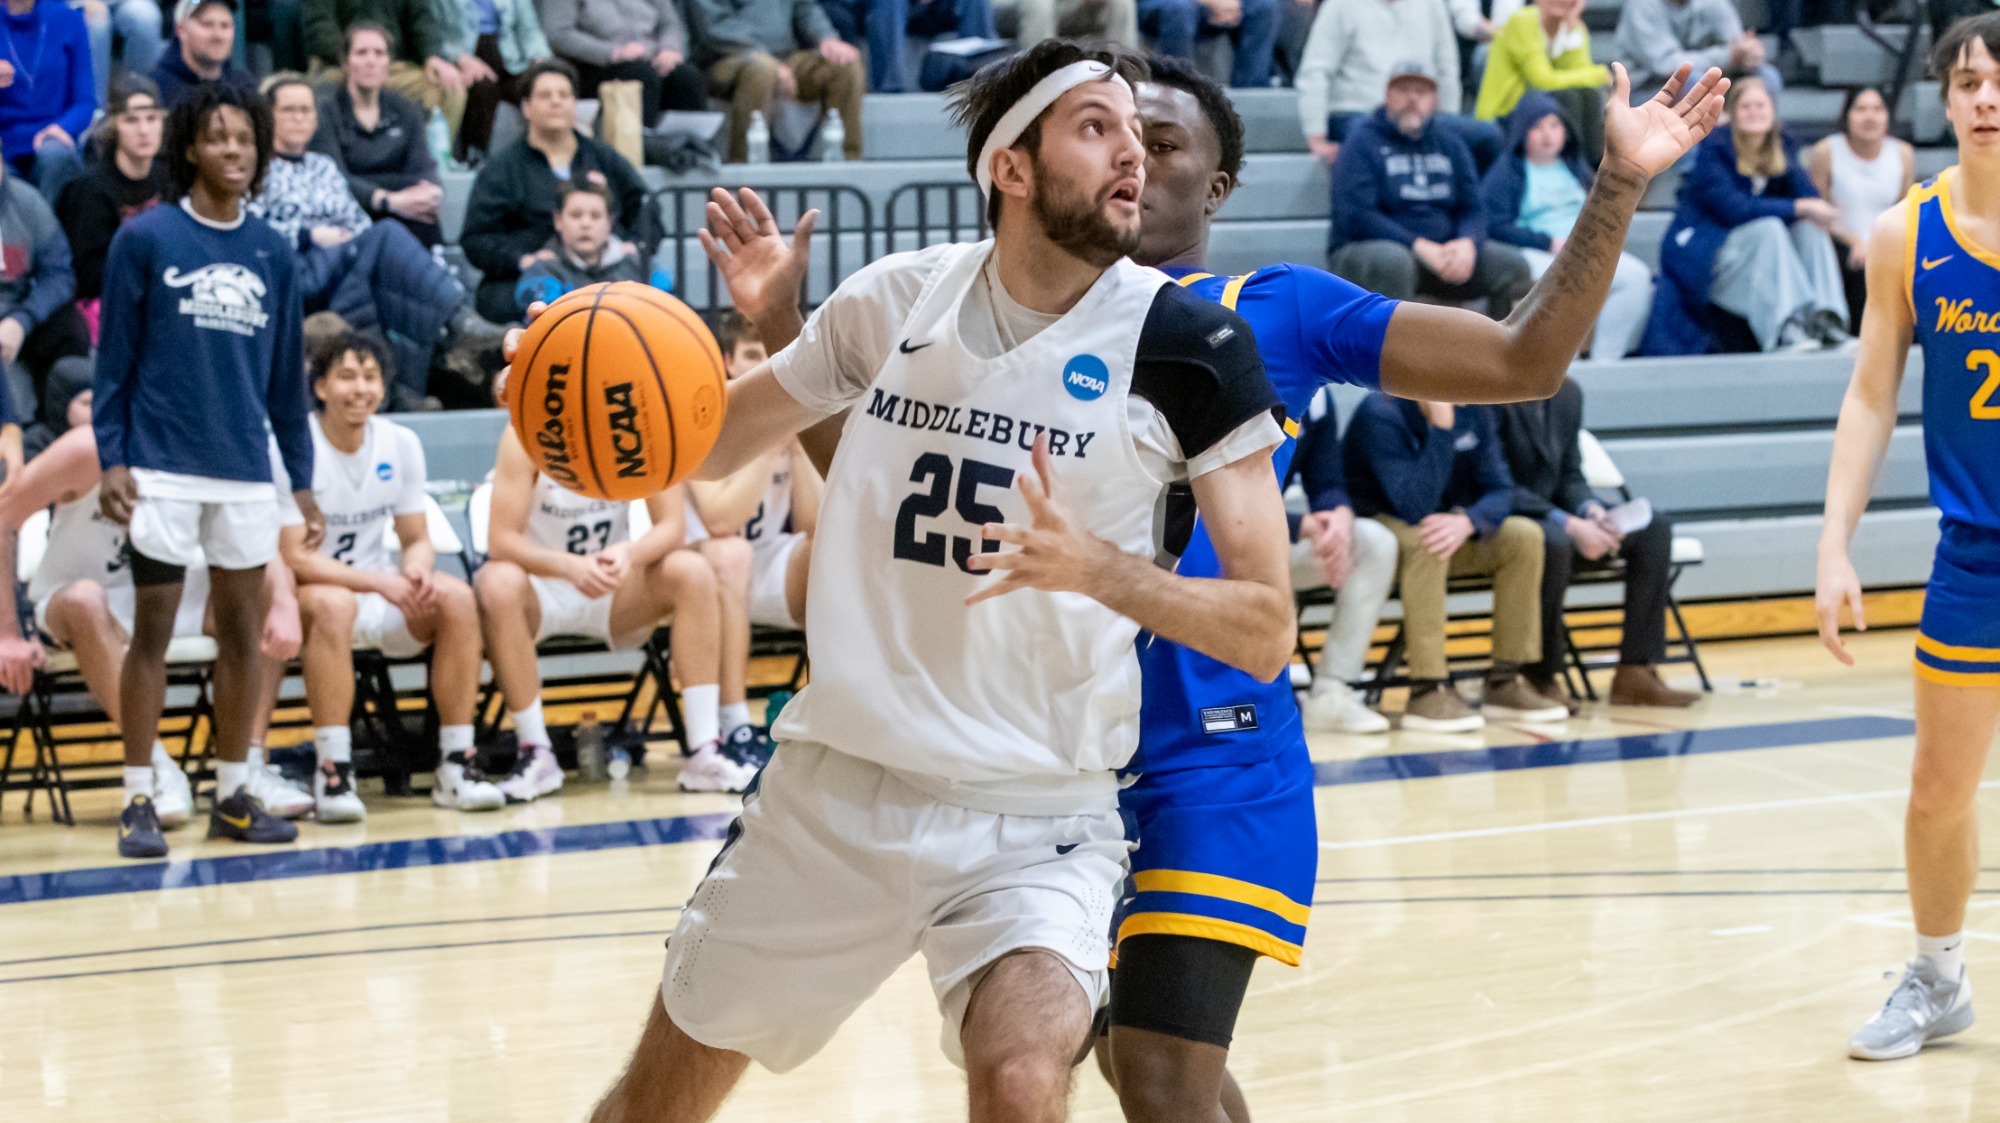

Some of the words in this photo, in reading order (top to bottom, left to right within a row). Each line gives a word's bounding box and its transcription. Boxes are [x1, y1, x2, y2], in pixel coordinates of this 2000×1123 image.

[1935, 296, 2000, 334] Worc
[1068, 371, 1106, 394] NCAA
[1965, 349, 2000, 420] 2
[536, 363, 585, 491] Wilson
[604, 381, 647, 479] NCAA
[866, 387, 1096, 459] MIDDLEBURY
[333, 532, 357, 565] 2
[893, 451, 1015, 576] 25
[1240, 711, 1253, 723] M
